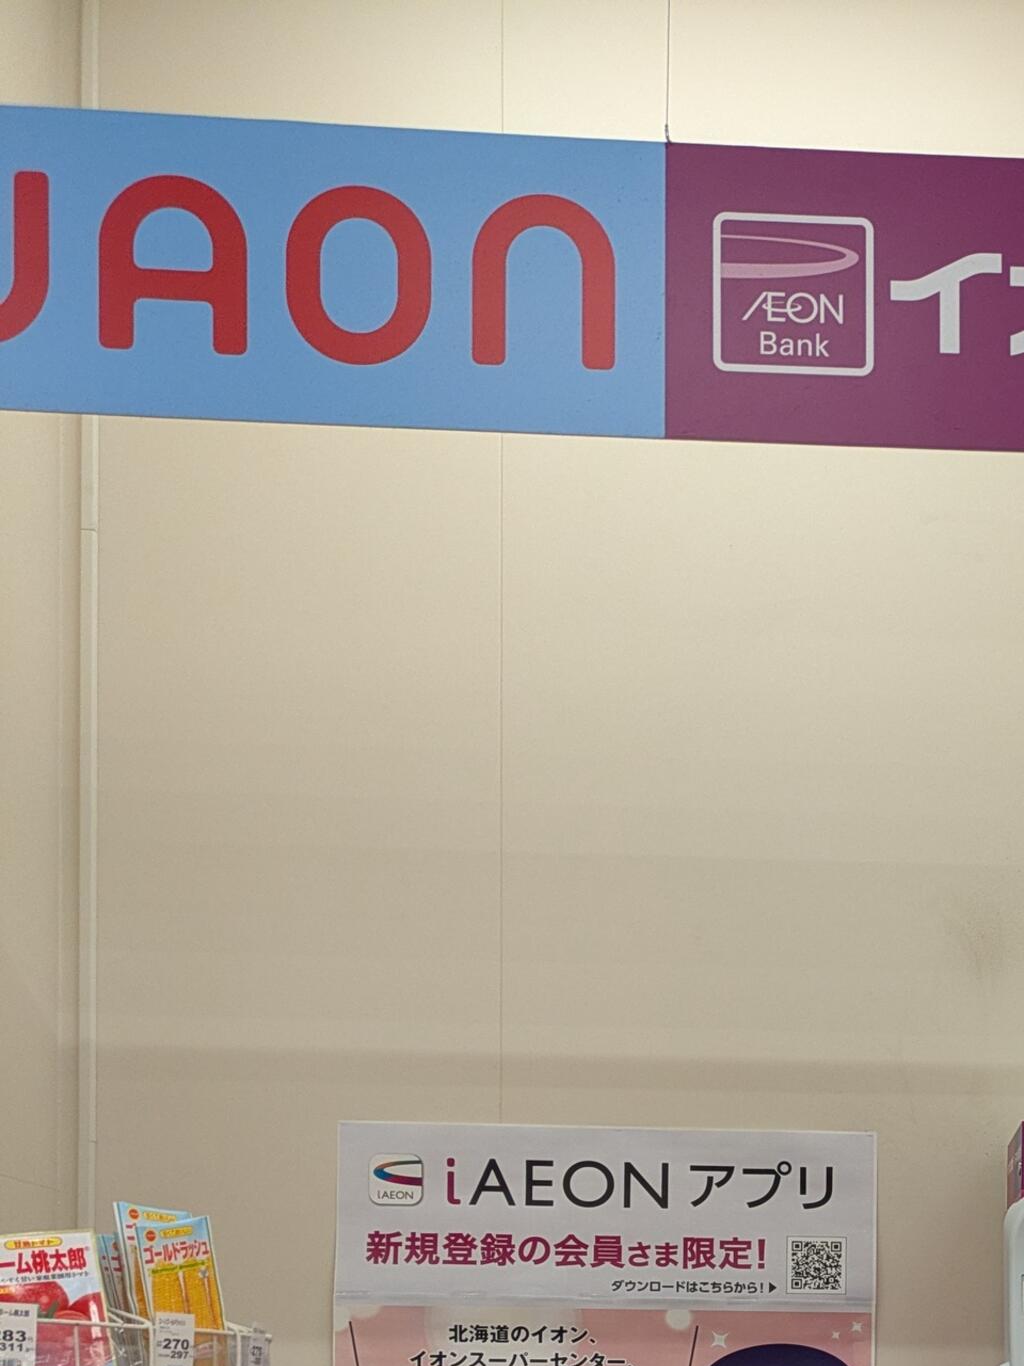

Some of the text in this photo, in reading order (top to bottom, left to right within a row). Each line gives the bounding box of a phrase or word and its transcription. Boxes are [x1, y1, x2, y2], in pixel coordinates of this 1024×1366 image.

[759, 330, 830, 359] Bank
[446, 1157, 833, 1210] iAEON アプリ
[143, 1239, 210, 1265] ゴールドラッシュ
[366, 1231, 766, 1269] 新規登録の会員さま限定!
[611, 1280, 764, 1294] ダウンロードはこちらから!
[0, 1330, 26, 1342] 83
[163, 1338, 190, 1350] 270
[448, 1324, 597, 1344] 北海道のイオン、
[170, 1350, 190, 1360] 297
